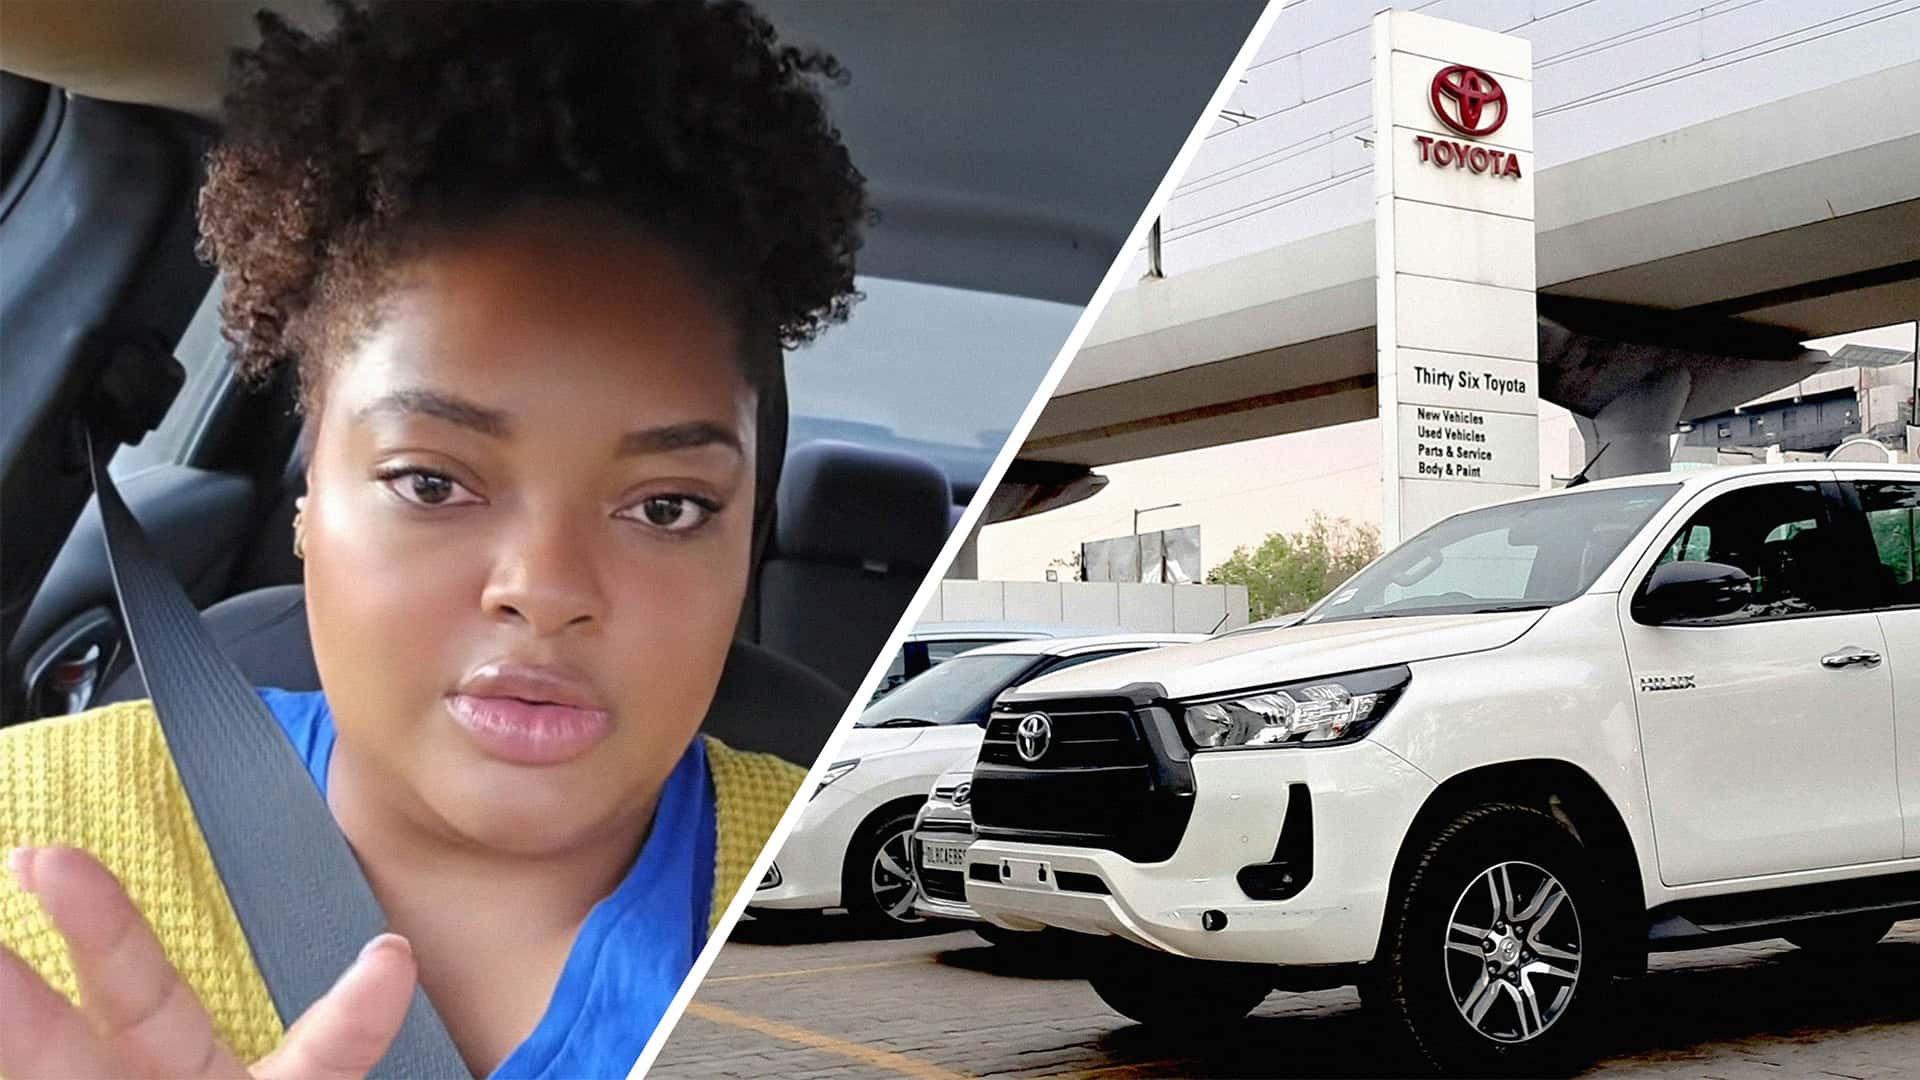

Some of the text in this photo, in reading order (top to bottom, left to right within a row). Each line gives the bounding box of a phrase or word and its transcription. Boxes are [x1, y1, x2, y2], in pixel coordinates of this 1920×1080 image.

[1416, 135, 1522, 179] TOYOTA
[1414, 366, 1526, 395] Thirty Six Toyota
[1417, 407, 1484, 425] New Vehicles
[1417, 425, 1486, 442] Used Vehicles
[1418, 444, 1492, 461] Parts & Service
[1418, 462, 1481, 478] Body & Paint
[1640, 674, 1696, 692] HILUX
